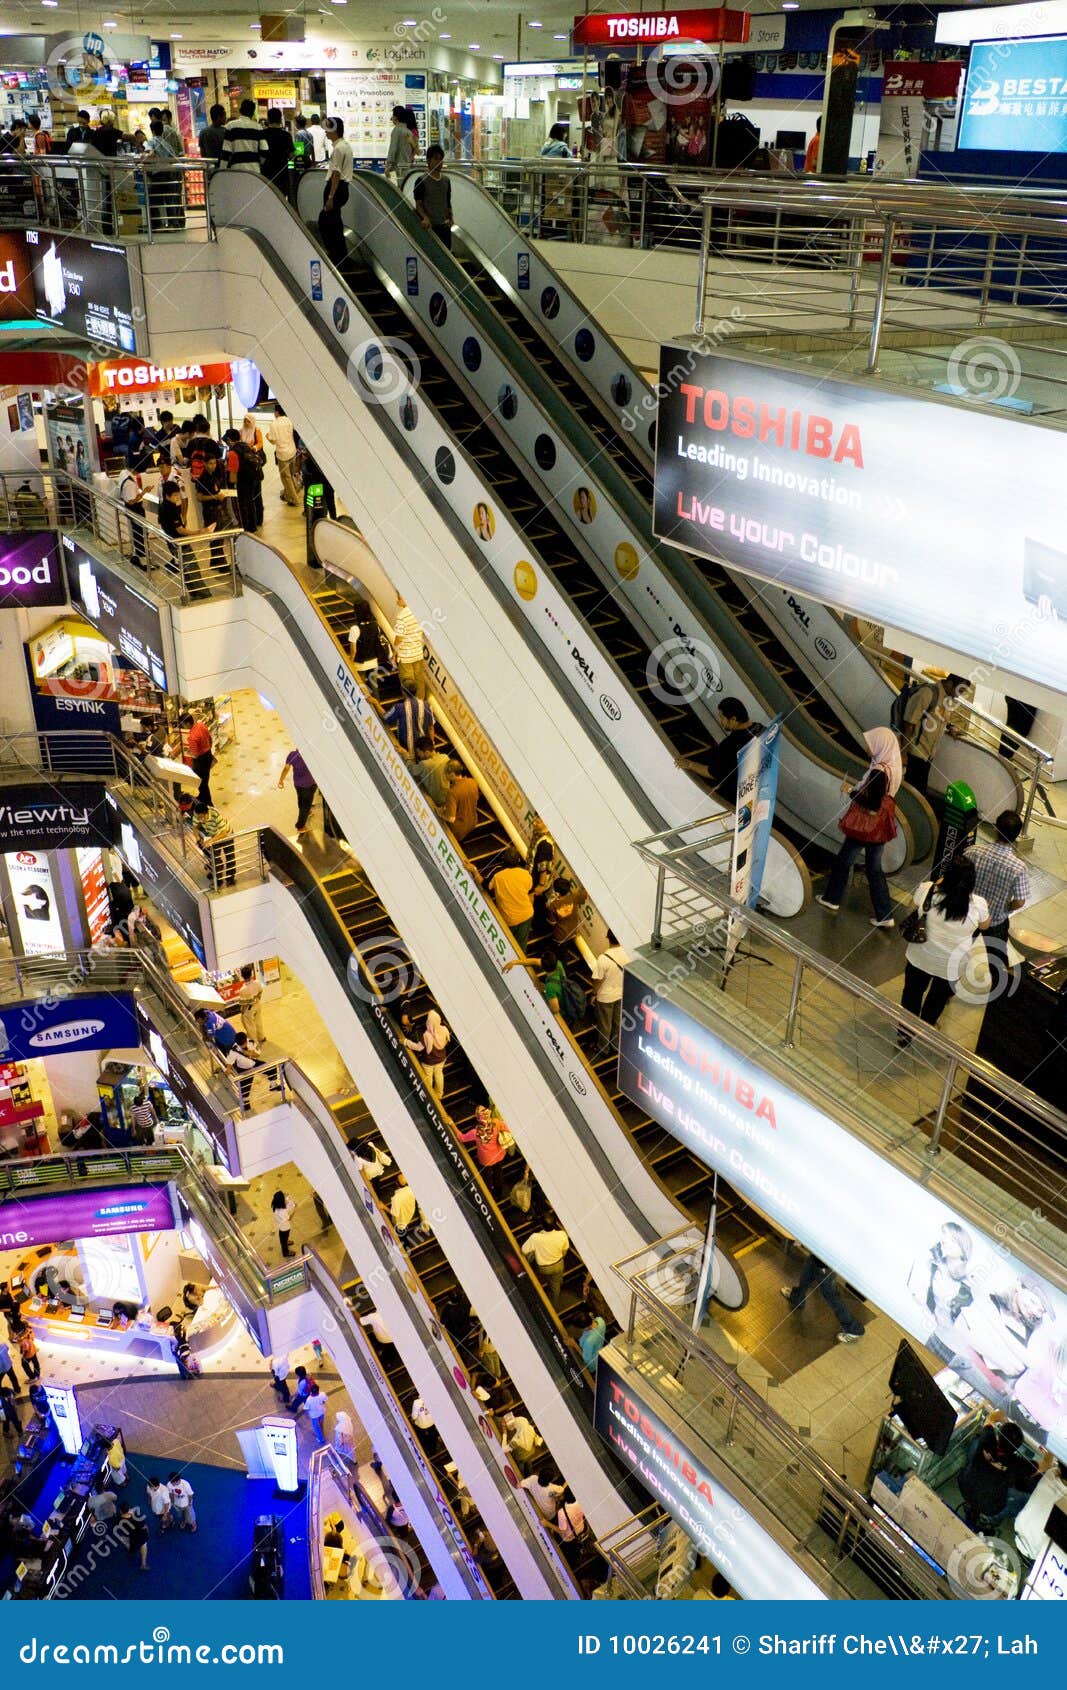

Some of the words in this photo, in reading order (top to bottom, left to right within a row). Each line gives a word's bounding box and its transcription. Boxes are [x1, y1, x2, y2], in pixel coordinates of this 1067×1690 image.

[87, 32, 102, 51] hp
[607, 16, 679, 37] TOSHIBA
[757, 30, 780, 42] Store
[384, 48, 425, 62] Logitech
[257, 88, 294, 97] ENTRANCE
[103, 364, 203, 387] TOSHIBA
[680, 383, 865, 469] TOSHIBA
[677, 435, 748, 480] Leading
[752, 457, 863, 509] Innovation
[676, 491, 724, 531] Live
[730, 514, 796, 554] your
[799, 533, 900, 589] Colour
[786, 595, 812, 628] DELL
[673, 624, 697, 657] DELL
[816, 638, 836, 660] intel
[571, 645, 596, 685] DELL
[55, 698, 106, 715] ESYINK
[601, 694, 621, 720] intel
[422, 644, 448, 693] DELL
[449, 693, 525, 811] AUTHORISED
[336, 664, 363, 715] DELL
[364, 715, 438, 838] AUTHORISED
[437, 838, 507, 960] RETAILERS.
[10, 828, 24, 837] the
[26, 826, 44, 835] next
[46, 825, 90, 835] technology
[37, 1025, 99, 1042] SAMSUNG
[545, 1028, 568, 1062] DELL
[640, 1002, 778, 1131] TOSHIBA
[370, 997, 398, 1049] YOURS
[398, 1050, 408, 1068] IS
[408, 1068, 427, 1101] THE
[426, 1102, 470, 1181] ULTIMATE
[570, 1072, 586, 1095] intel
[637, 1035, 692, 1090] Leading
[695, 1079, 775, 1153] Innovation
[637, 1071, 674, 1114] Live
[677, 1107, 728, 1158] your
[729, 1148, 799, 1212] Colour
[100, 1204, 143, 1215] SAMSUNG
[0, 1231, 35, 1245] ne.
[610, 1379, 714, 1507] TOSHIBA
[609, 1402, 651, 1451] Leading
[651, 1449, 713, 1522] Innovation
[609, 1425, 637, 1466] Live
[639, 1462, 678, 1505] your
[436, 1489, 481, 1583] YOURS
